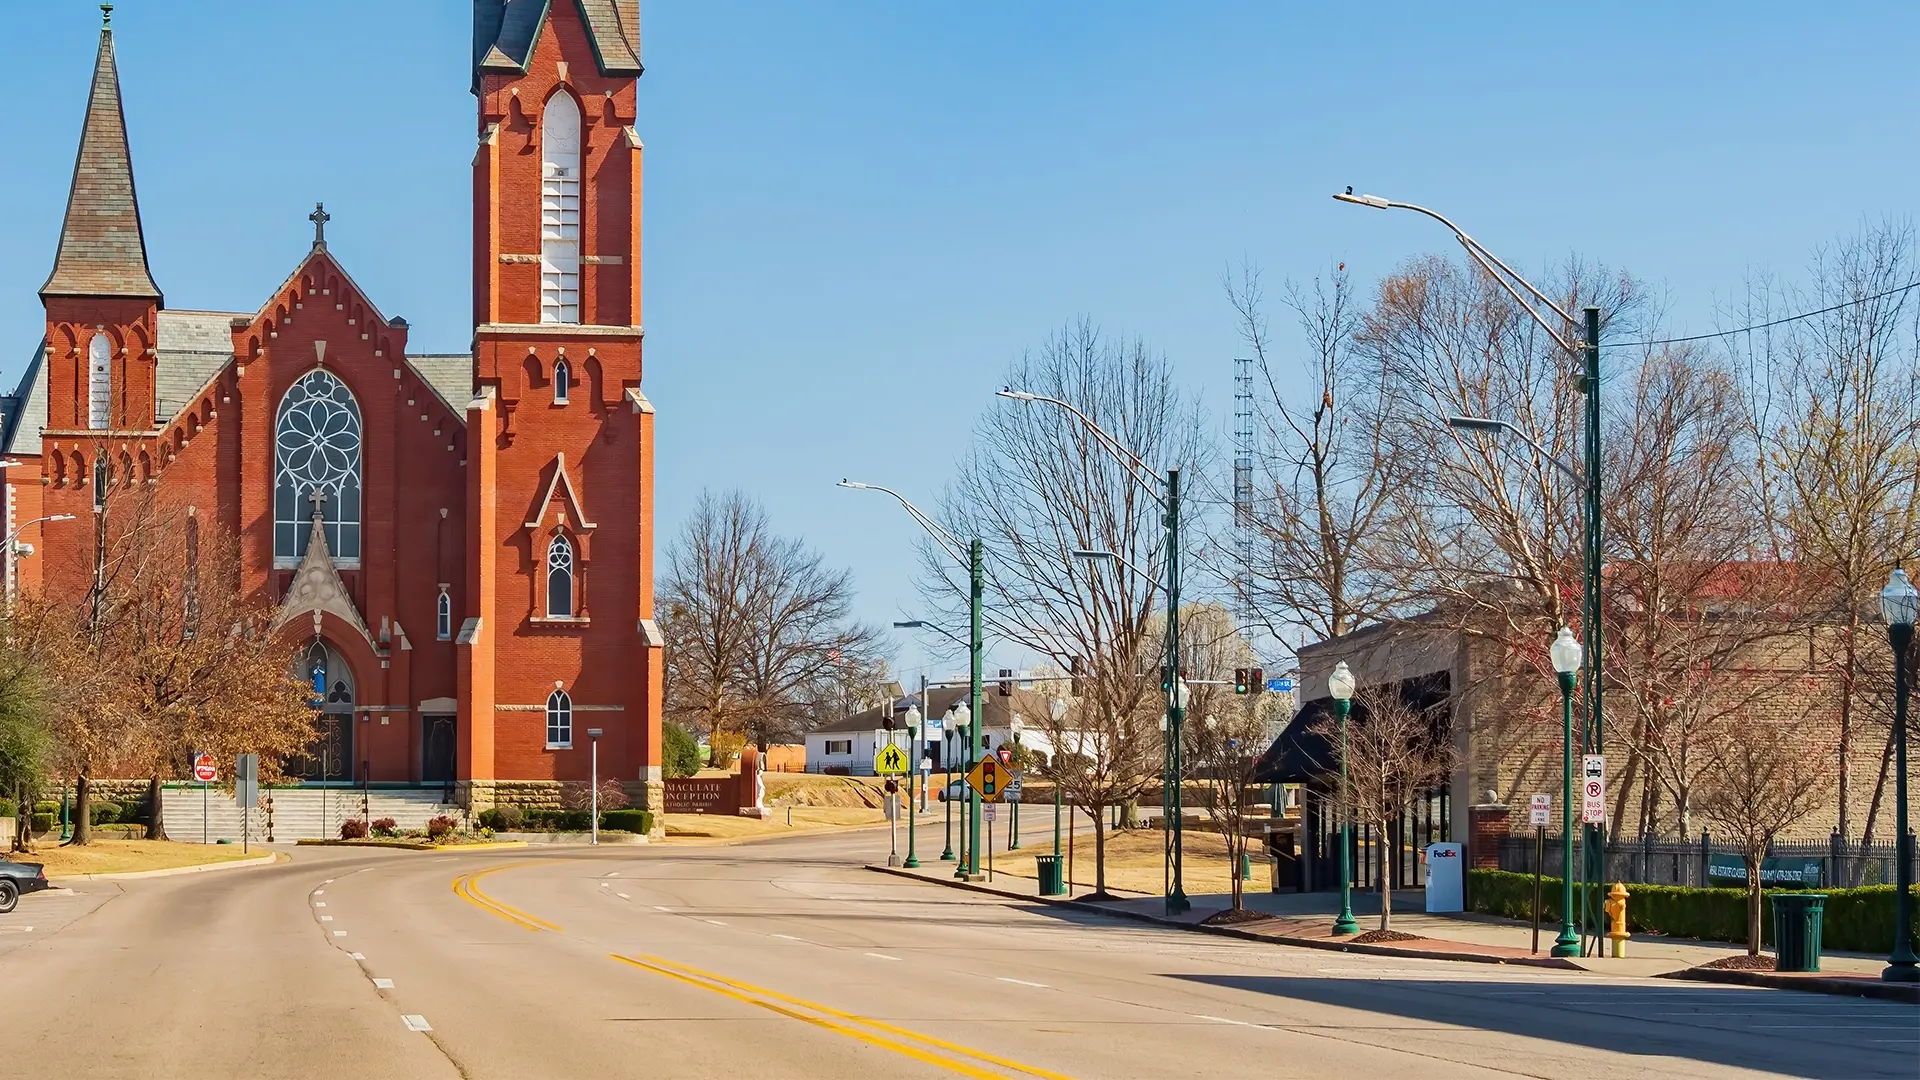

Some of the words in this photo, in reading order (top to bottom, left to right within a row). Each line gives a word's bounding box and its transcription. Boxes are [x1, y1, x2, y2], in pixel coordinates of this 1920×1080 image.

[664, 783, 722, 792] MACULATE
[1006, 781, 1020, 789] 25
[664, 792, 720, 800] ONCEPTION
[1433, 849, 1457, 858] FedEx
